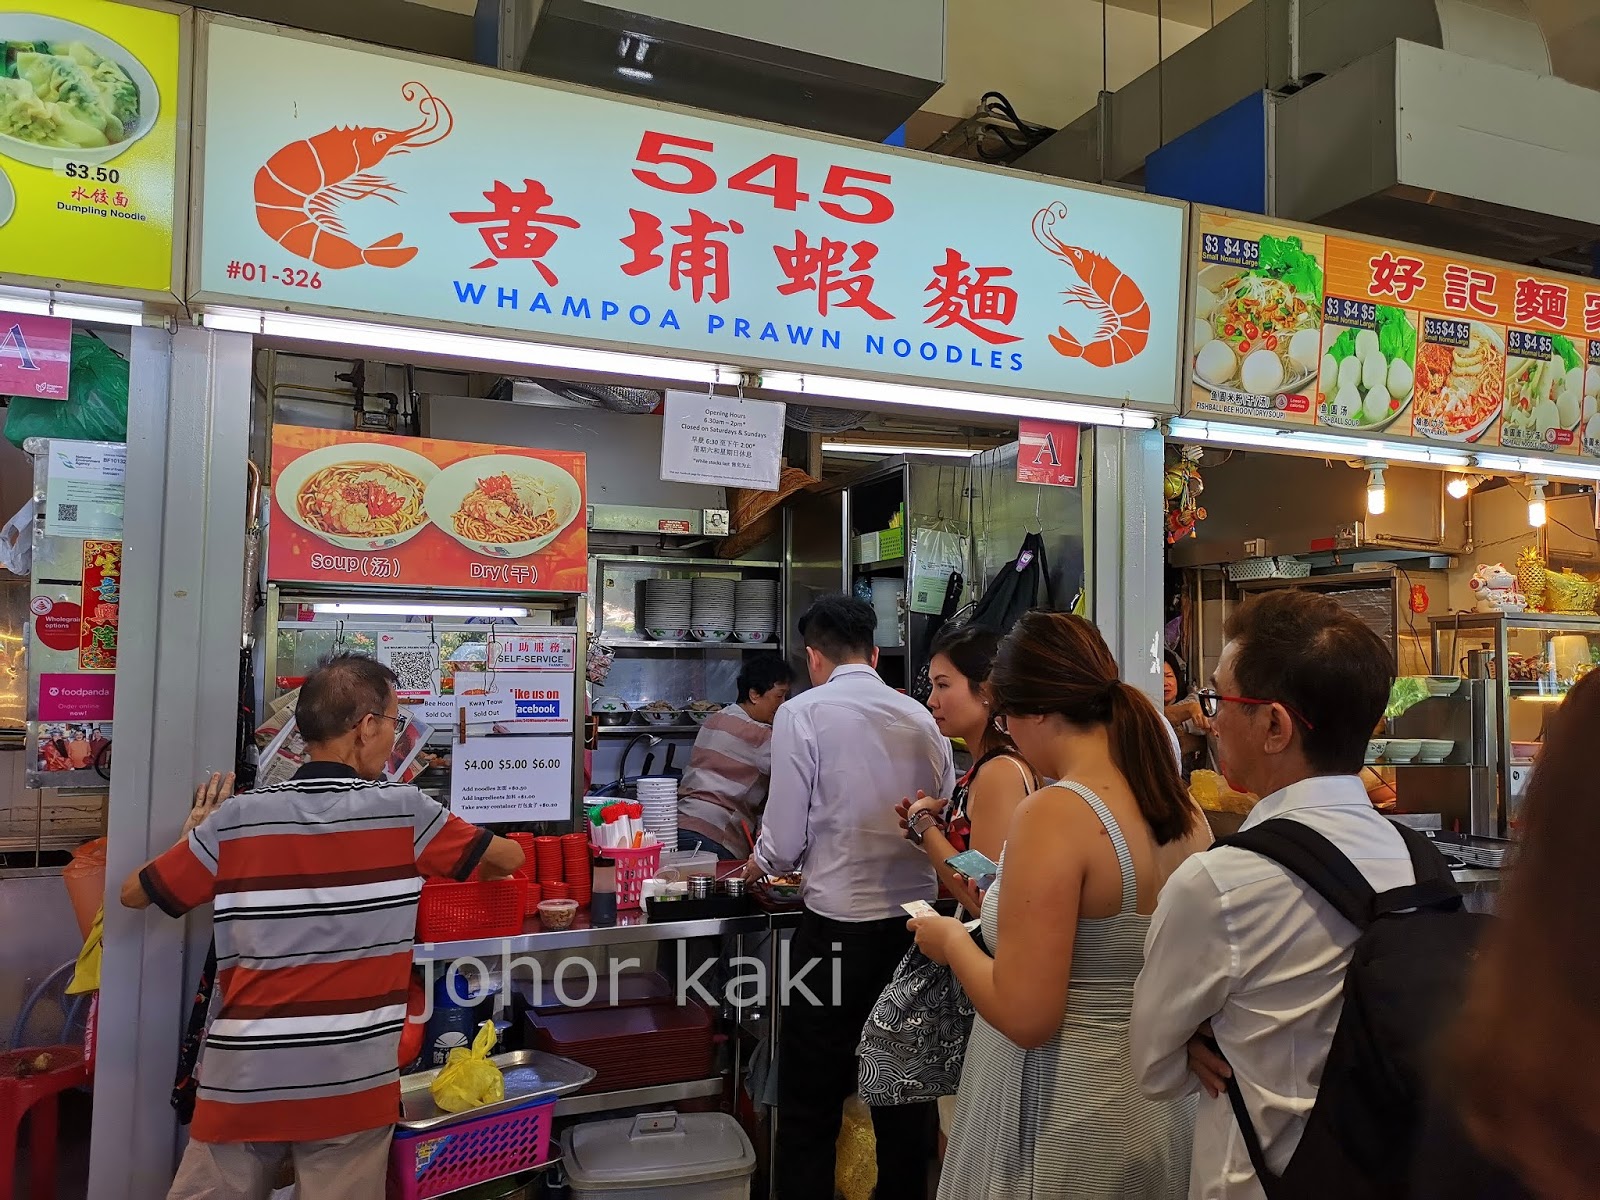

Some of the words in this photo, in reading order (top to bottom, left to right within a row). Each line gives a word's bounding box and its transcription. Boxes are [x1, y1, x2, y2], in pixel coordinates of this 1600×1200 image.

[65, 162, 120, 184] $3.50
[631, 130, 895, 225] 545
[57, 201, 107, 218] Dumpling
[110, 209, 146, 221] Noodle
[1205, 234, 1218, 253] $3
[1224, 237, 1240, 256] $4
[1243, 241, 1258, 259] $5
[1202, 252, 1219, 261] Small
[1220, 254, 1241, 264] Normal
[1241, 258, 1258, 267] Large
[226, 261, 323, 290] #01-326
[1326, 297, 1339, 315] $3
[1343, 300, 1359, 318] $4
[1361, 304, 1375, 320] $5
[453, 280, 681, 330] WHAMPOA
[708, 314, 841, 350] PRAWN
[866, 336, 1024, 372] NOODLES
[1324, 314, 1339, 322] Small
[1340, 316, 1359, 325] Normal
[1360, 319, 1375, 329] Large
[1457, 324, 1469, 339] $5
[0, 323, 40, 371] A
[1509, 331, 1520, 348] $3
[1524, 333, 1537, 350] $4
[1539, 336, 1552, 353] $5
[705, 408, 729, 418] Opening
[1196, 401, 1222, 412] FISHBALL
[1224, 405, 1234, 413] BEE
[1235, 407, 1252, 416] HOON
[681, 423, 700, 431] Closed
[709, 426, 737, 436] Saturdays
[744, 430, 767, 439] Sundays
[1032, 431, 1062, 467] A
[498, 655, 564, 663] SELF-SERVICE
[61, 687, 110, 697] foodpanda
[510, 688, 530, 699] ike
[532, 690, 544, 699] us
[547, 690, 559, 699] on
[469, 700, 485, 708] Kway
[473, 710, 487, 718] Sold
[464, 759, 494, 771] $4.00
[498, 759, 528, 770] $5.00
[532, 758, 561, 770] $6.00
